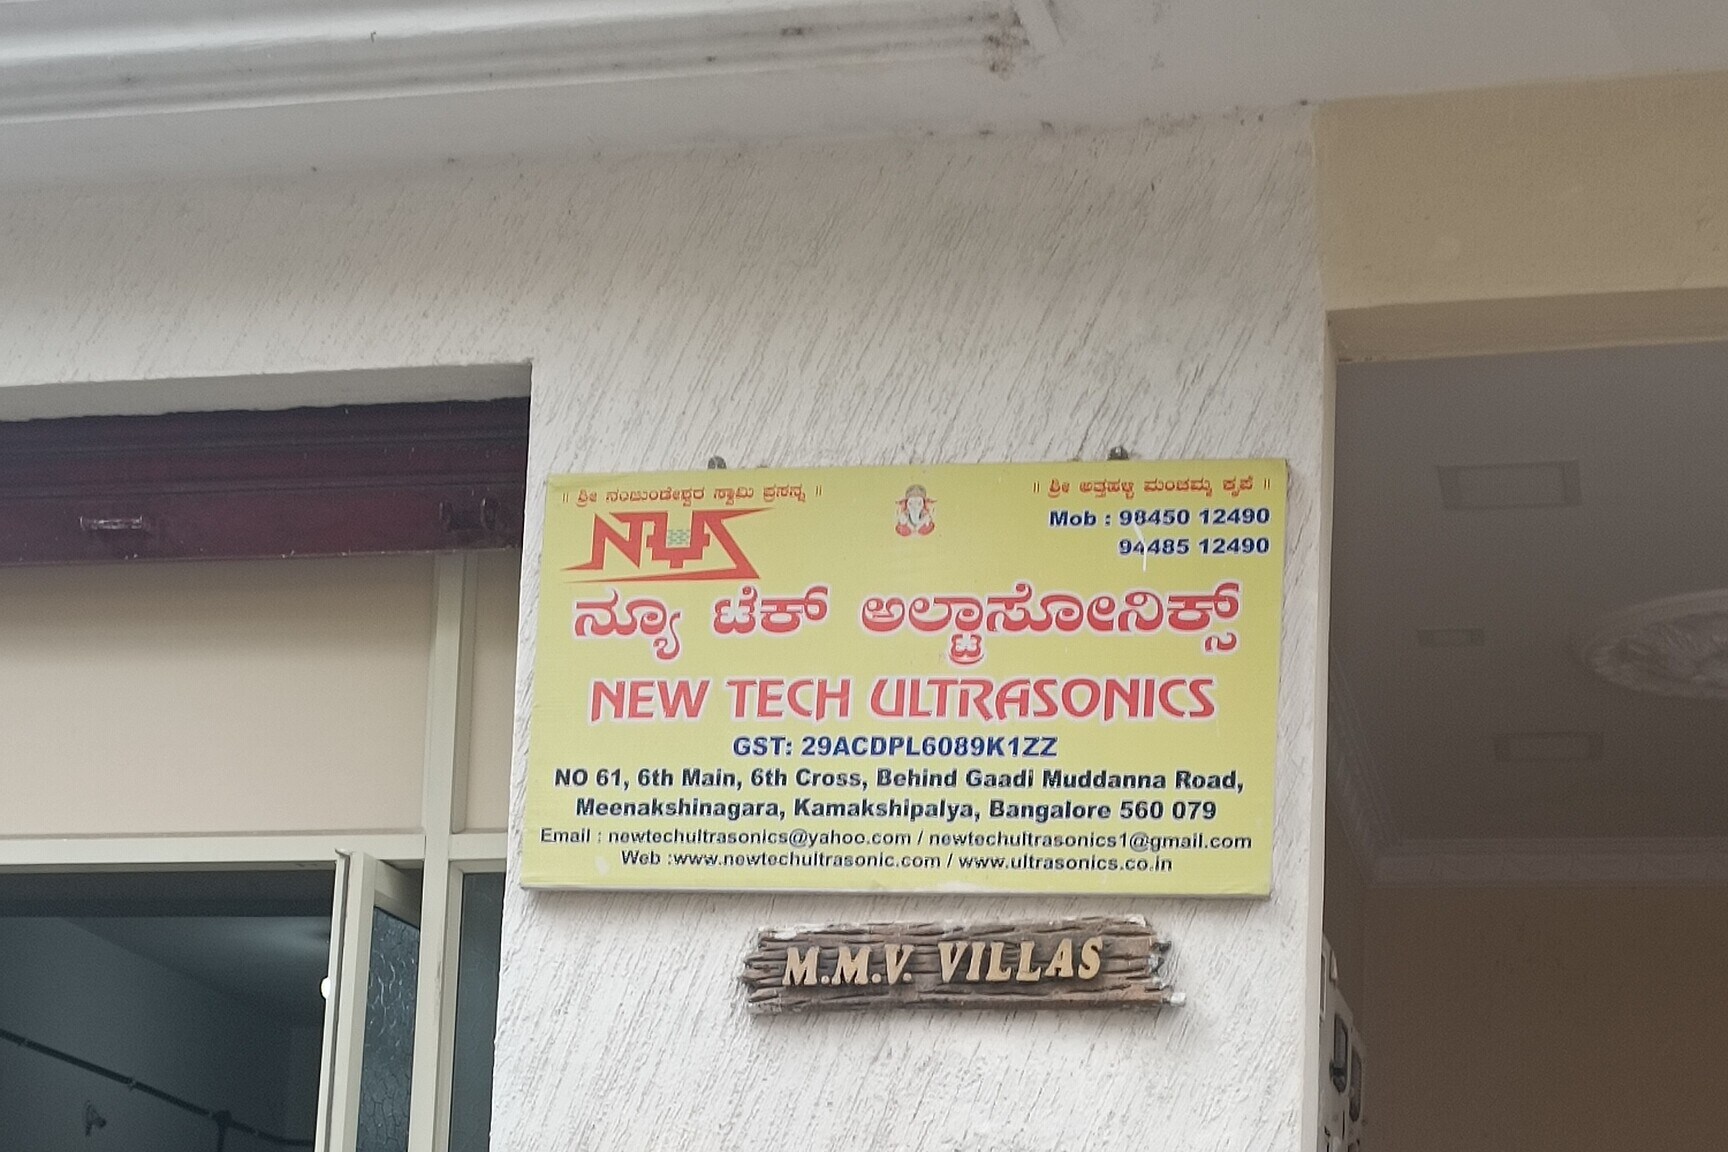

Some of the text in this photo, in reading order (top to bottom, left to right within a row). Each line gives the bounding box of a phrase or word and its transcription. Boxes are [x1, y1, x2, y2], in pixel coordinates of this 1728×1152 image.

[577, 490, 598, 508] ಶ್ರೀ
[713, 487, 754, 506] ಸ್ವಾಮಿ
[763, 485, 806, 503] ಪ್ರಸನ್ನ
[1048, 479, 1070, 498] ಶ್ರೀ
[1223, 475, 1253, 497] ಕೃಪೆ
[1049, 510, 1097, 527] Mob
[1119, 508, 1191, 527] 98450
[1198, 507, 1270, 525] 12490
[1198, 536, 1270, 555] 12490
[574, 590, 681, 661] ನ್ಯೂ
[713, 585, 829, 635] ಟೆಕ್
[591, 678, 1215, 722] NEW TECH ULTRASONICS
[733, 735, 1059, 758] GST: 29ACDPL6089K1ZZ
[554, 767, 1244, 794] NO 61, 6th Main, 6th Cross, Behind Gaadi Muddanna Road,
[576, 797, 1217, 824] Meenakshinagara, Kamakshipalya, Bangalore 560 079
[540, 827, 591, 844] Email
[608, 828, 912, 849] newtechultrasonics@yahoo.com
[929, 831, 1252, 853] newtechultrasonics1@gmail.com
[621, 849, 661, 866] Web
[958, 854, 1173, 872] www.ultrasonics.co.in
[782, 936, 1104, 986] M.M.V. VILLAS
